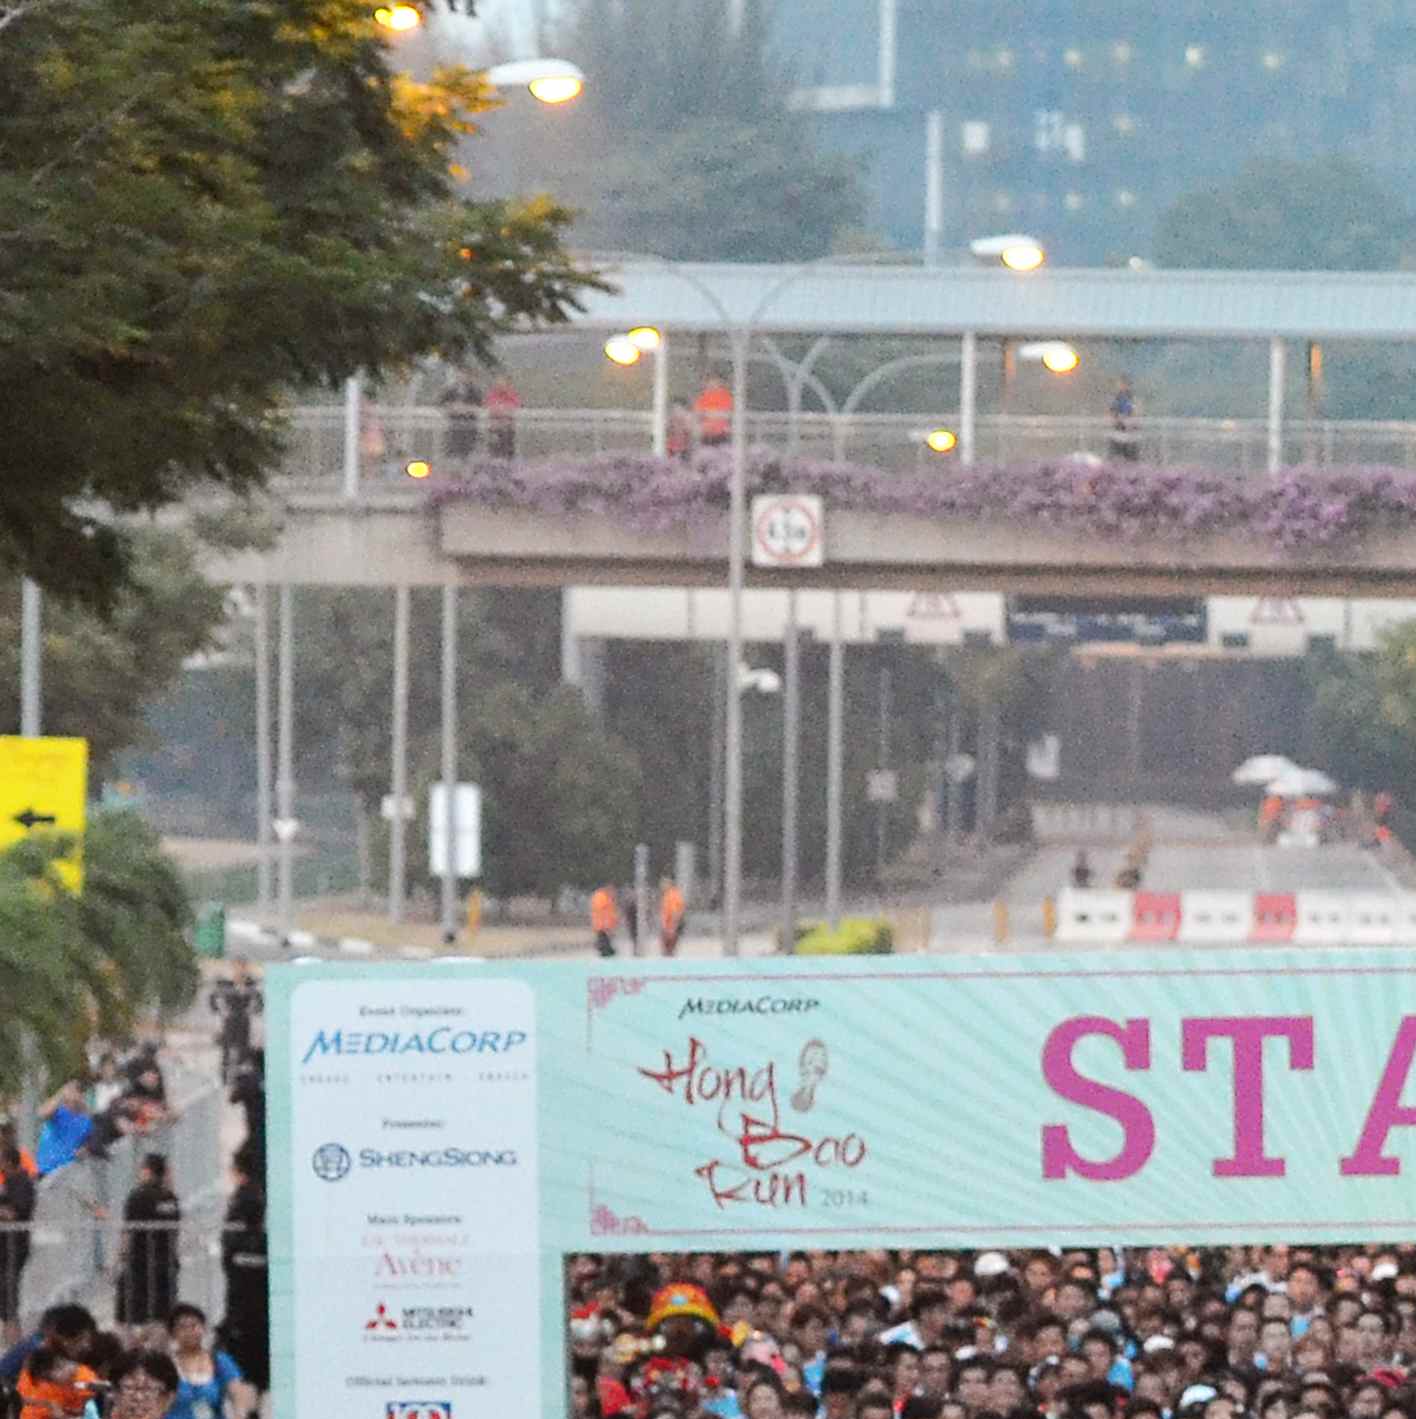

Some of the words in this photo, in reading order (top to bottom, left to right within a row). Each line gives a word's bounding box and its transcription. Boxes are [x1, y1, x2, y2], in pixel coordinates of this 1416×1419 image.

[679, 996, 820, 1019] MEDIACORP
[302, 1026, 528, 1064] MEDIACORP
[637, 1037, 779, 1137] Hong
[739, 1112, 867, 1170] Bao
[694, 1159, 807, 1209] Run
[821, 1189, 869, 1208] 2014
